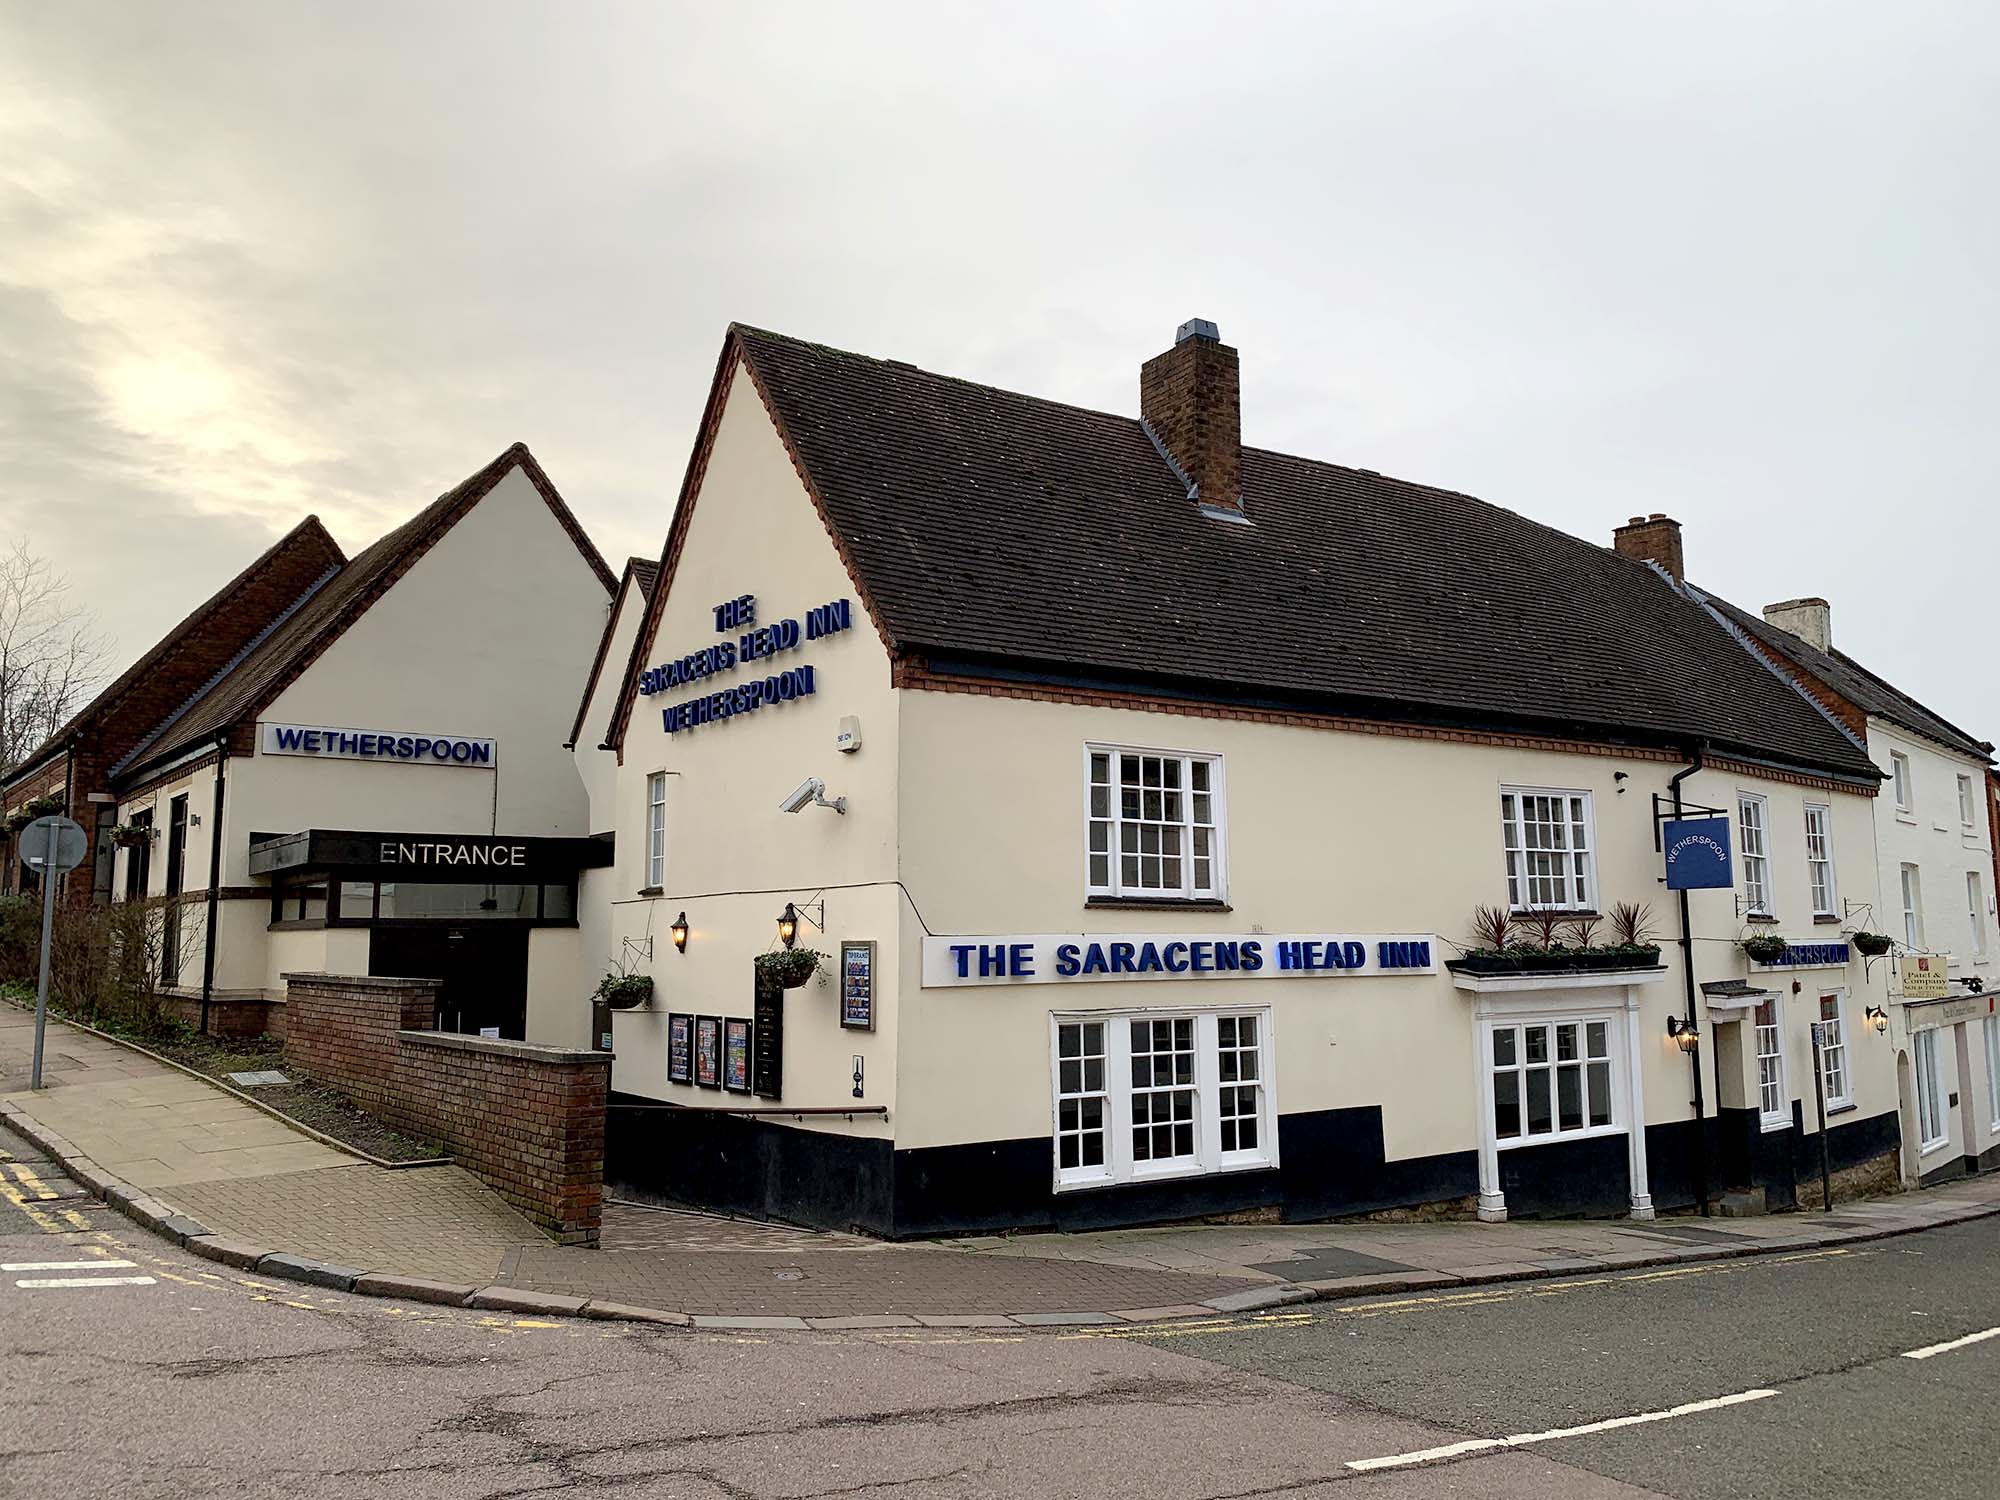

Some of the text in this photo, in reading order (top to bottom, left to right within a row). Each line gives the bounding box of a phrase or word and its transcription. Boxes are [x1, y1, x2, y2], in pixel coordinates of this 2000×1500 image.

[712, 594, 756, 632] THE
[639, 598, 851, 695] SARACENS HEAD INN
[662, 665, 817, 733] WETHERSPOON
[275, 727, 490, 763] WETHERSPOON
[379, 842, 526, 867] ENTRANCE
[1667, 835, 1727, 864] WETHERSPOON
[949, 940, 1431, 978] THE SARACENS HEAD INN
